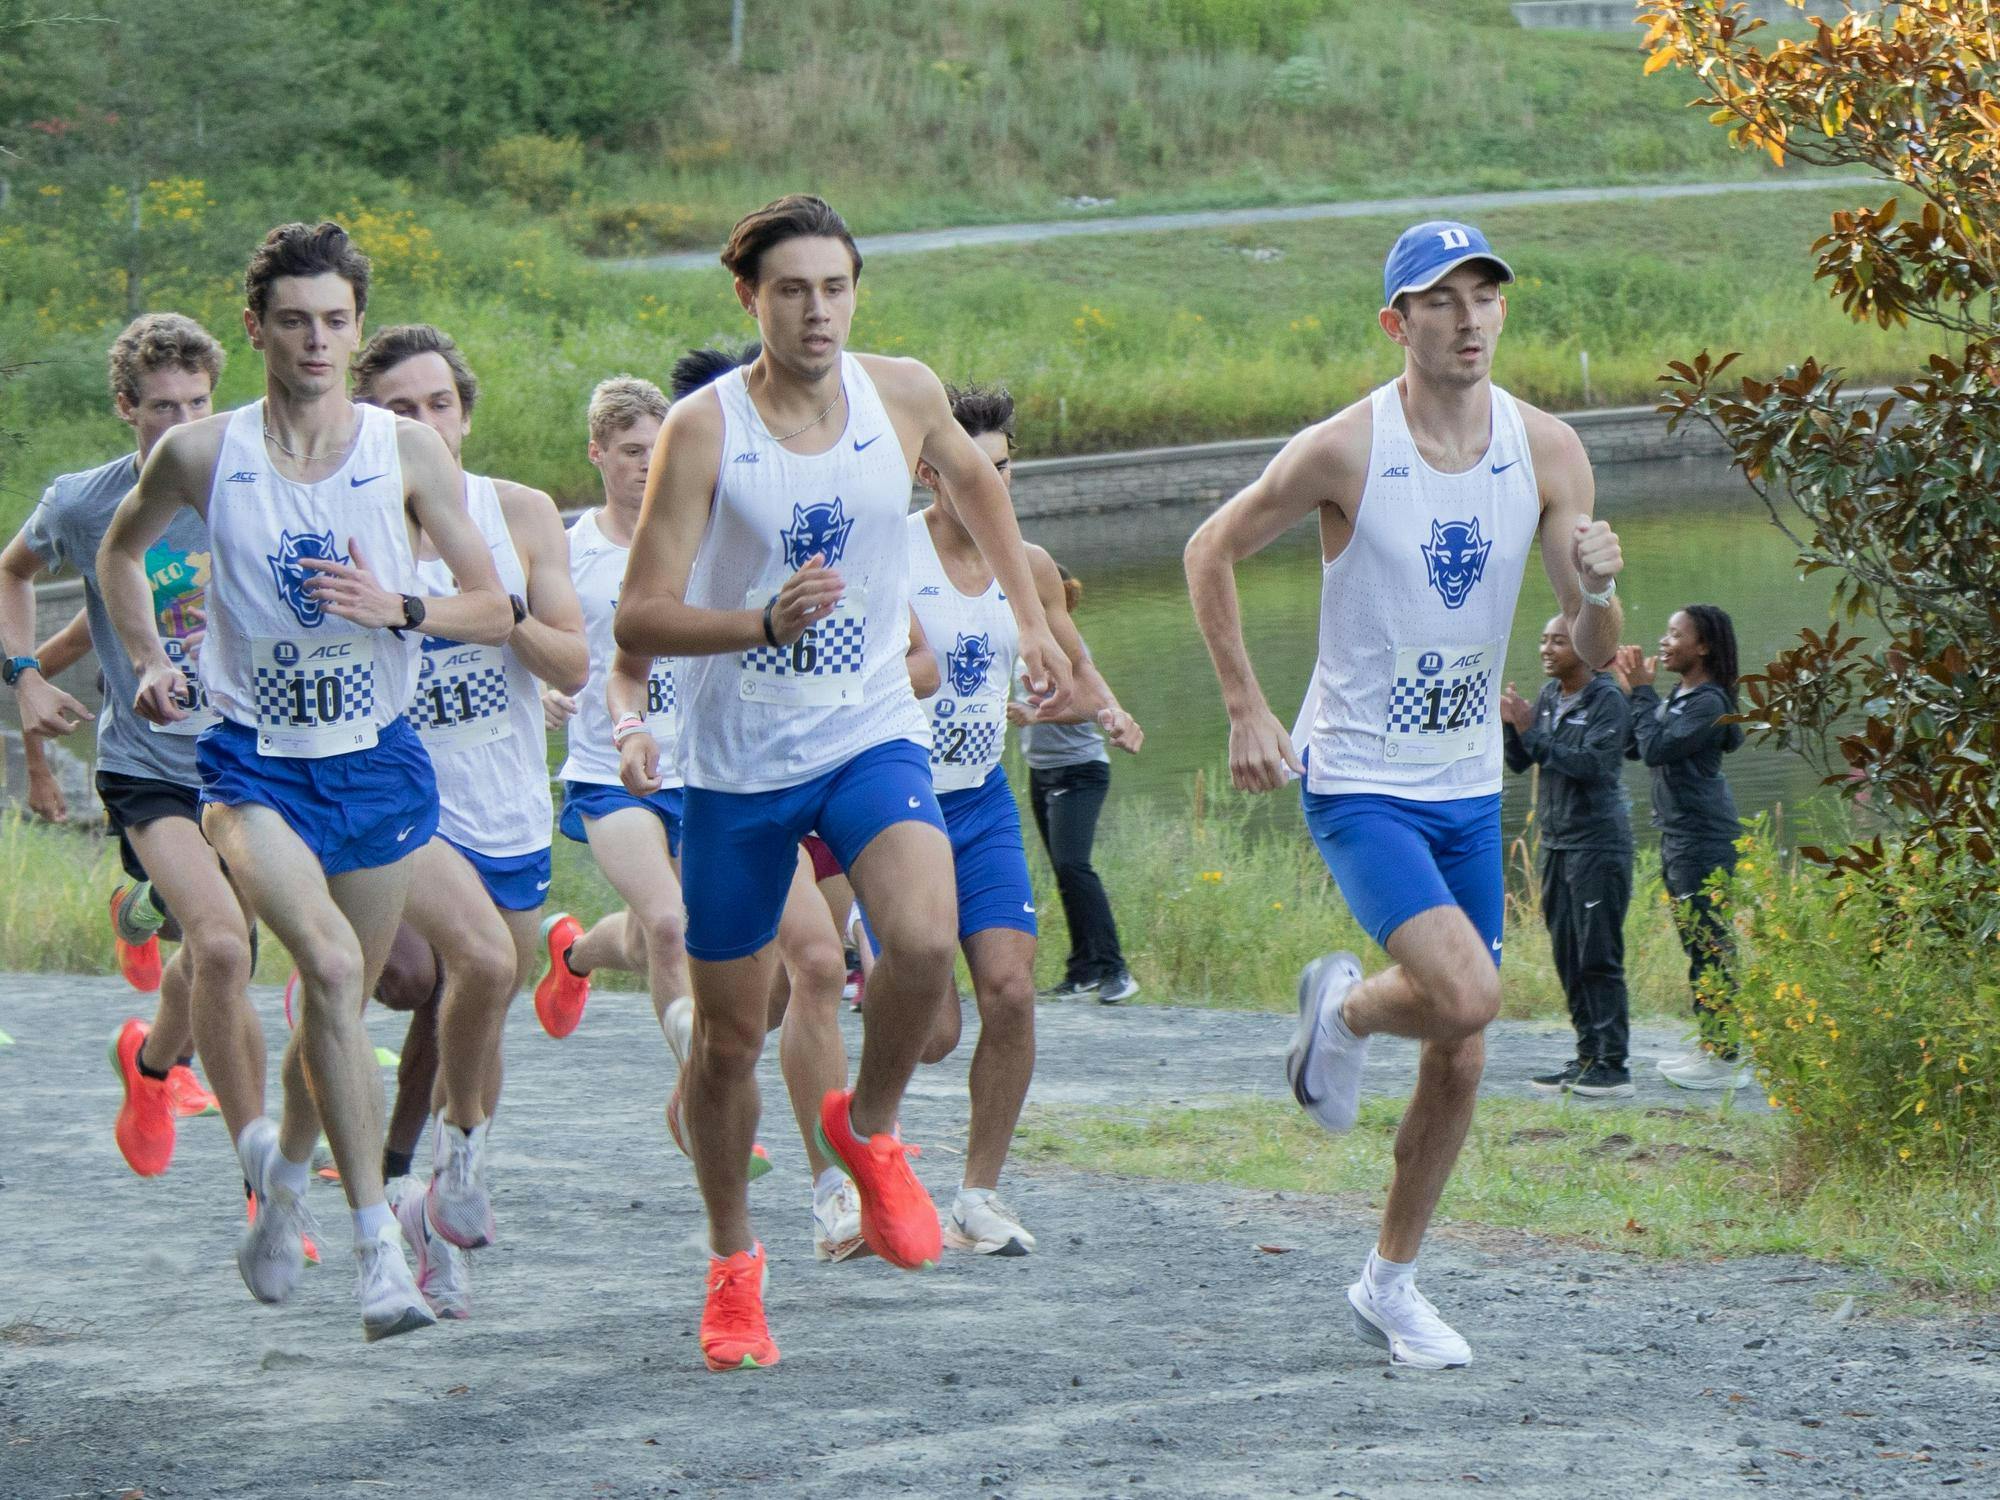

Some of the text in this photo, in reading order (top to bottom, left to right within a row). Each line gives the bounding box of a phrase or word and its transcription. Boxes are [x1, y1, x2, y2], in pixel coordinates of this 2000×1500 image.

[1438, 229, 1470, 250] D
[228, 471, 258, 481] ACC
[1383, 467, 1410, 477] ACC
[918, 587, 940, 595] ACC
[307, 642, 353, 659] ACC
[442, 649, 483, 668] ACC
[792, 628, 818, 673] 6
[1449, 651, 1485, 669] ACC
[289, 676, 343, 724] 10
[428, 681, 478, 726] 11
[960, 703, 989, 714] ACC
[1422, 684, 1469, 730] 12
[353, 734, 364, 745] 10
[943, 727, 967, 763] 2
